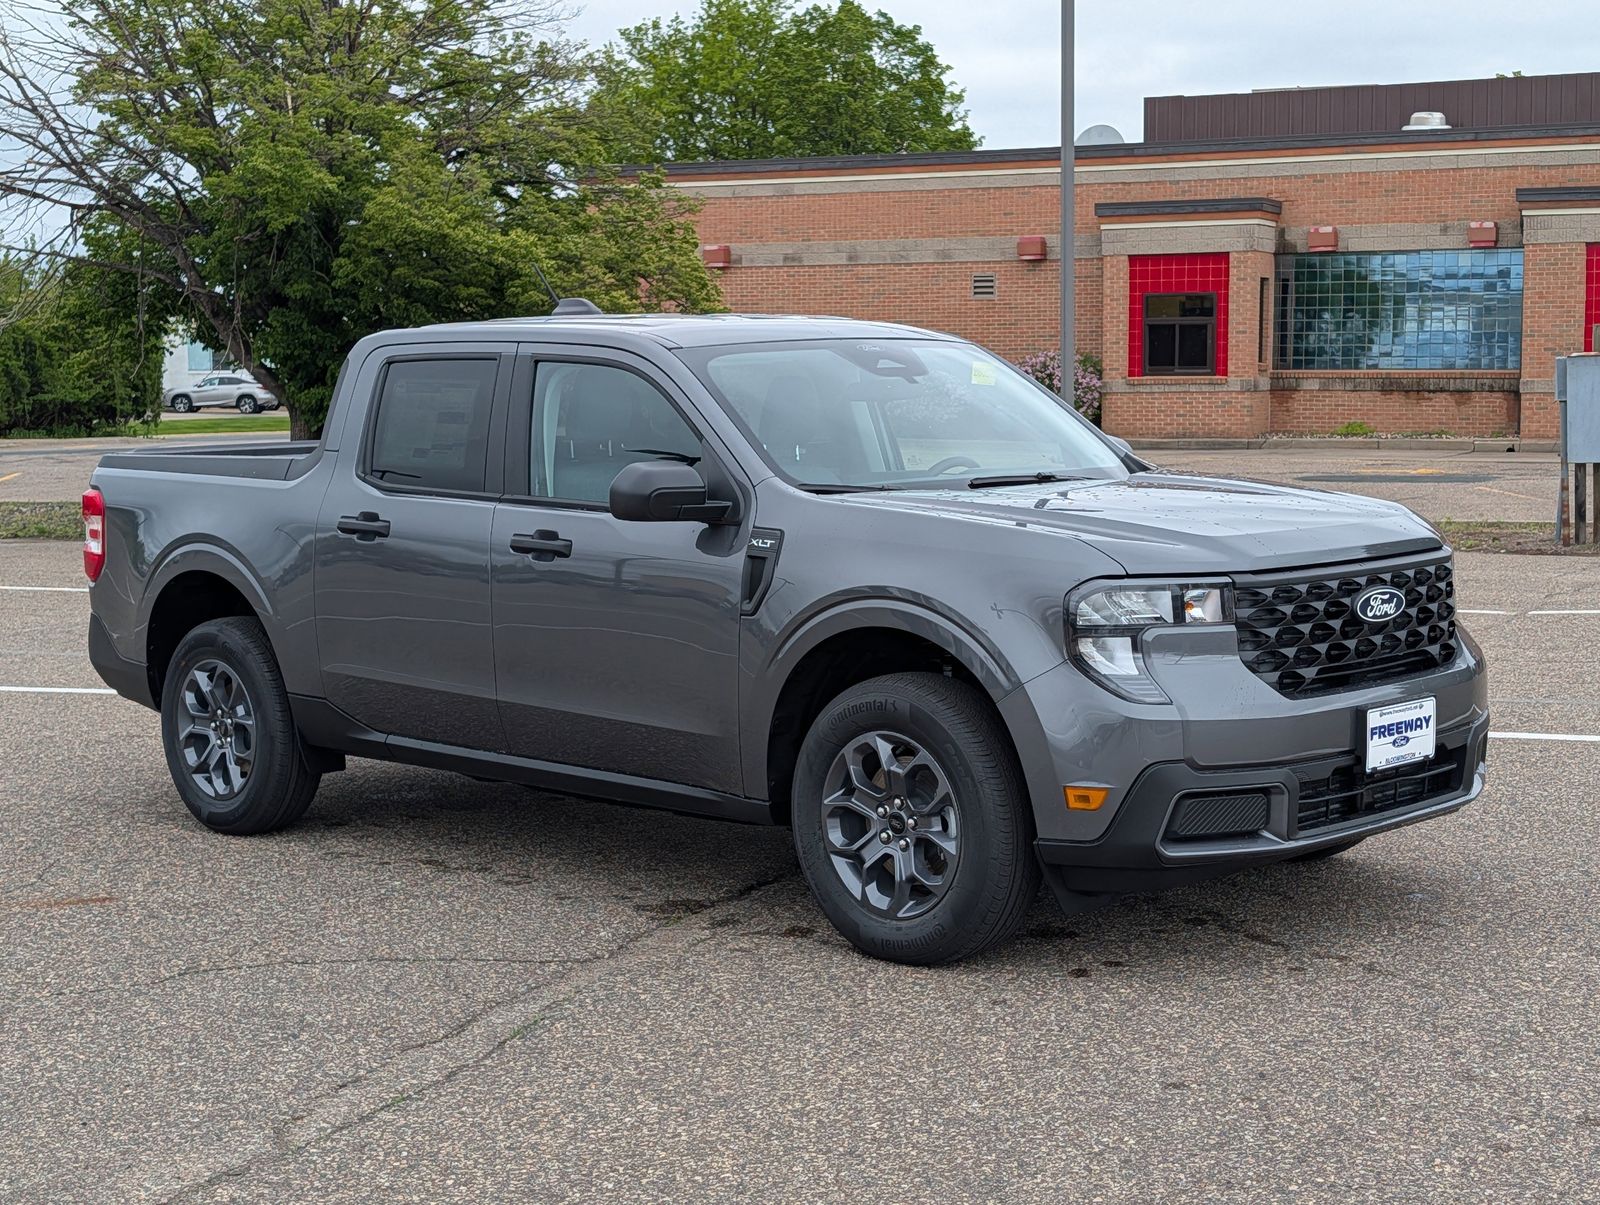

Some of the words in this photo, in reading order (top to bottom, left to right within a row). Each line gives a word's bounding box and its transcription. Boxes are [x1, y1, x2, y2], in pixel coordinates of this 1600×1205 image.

[749, 538, 775, 547] XLT
[1367, 594, 1397, 617] Ford
[1370, 715, 1432, 741] FREEWAY
